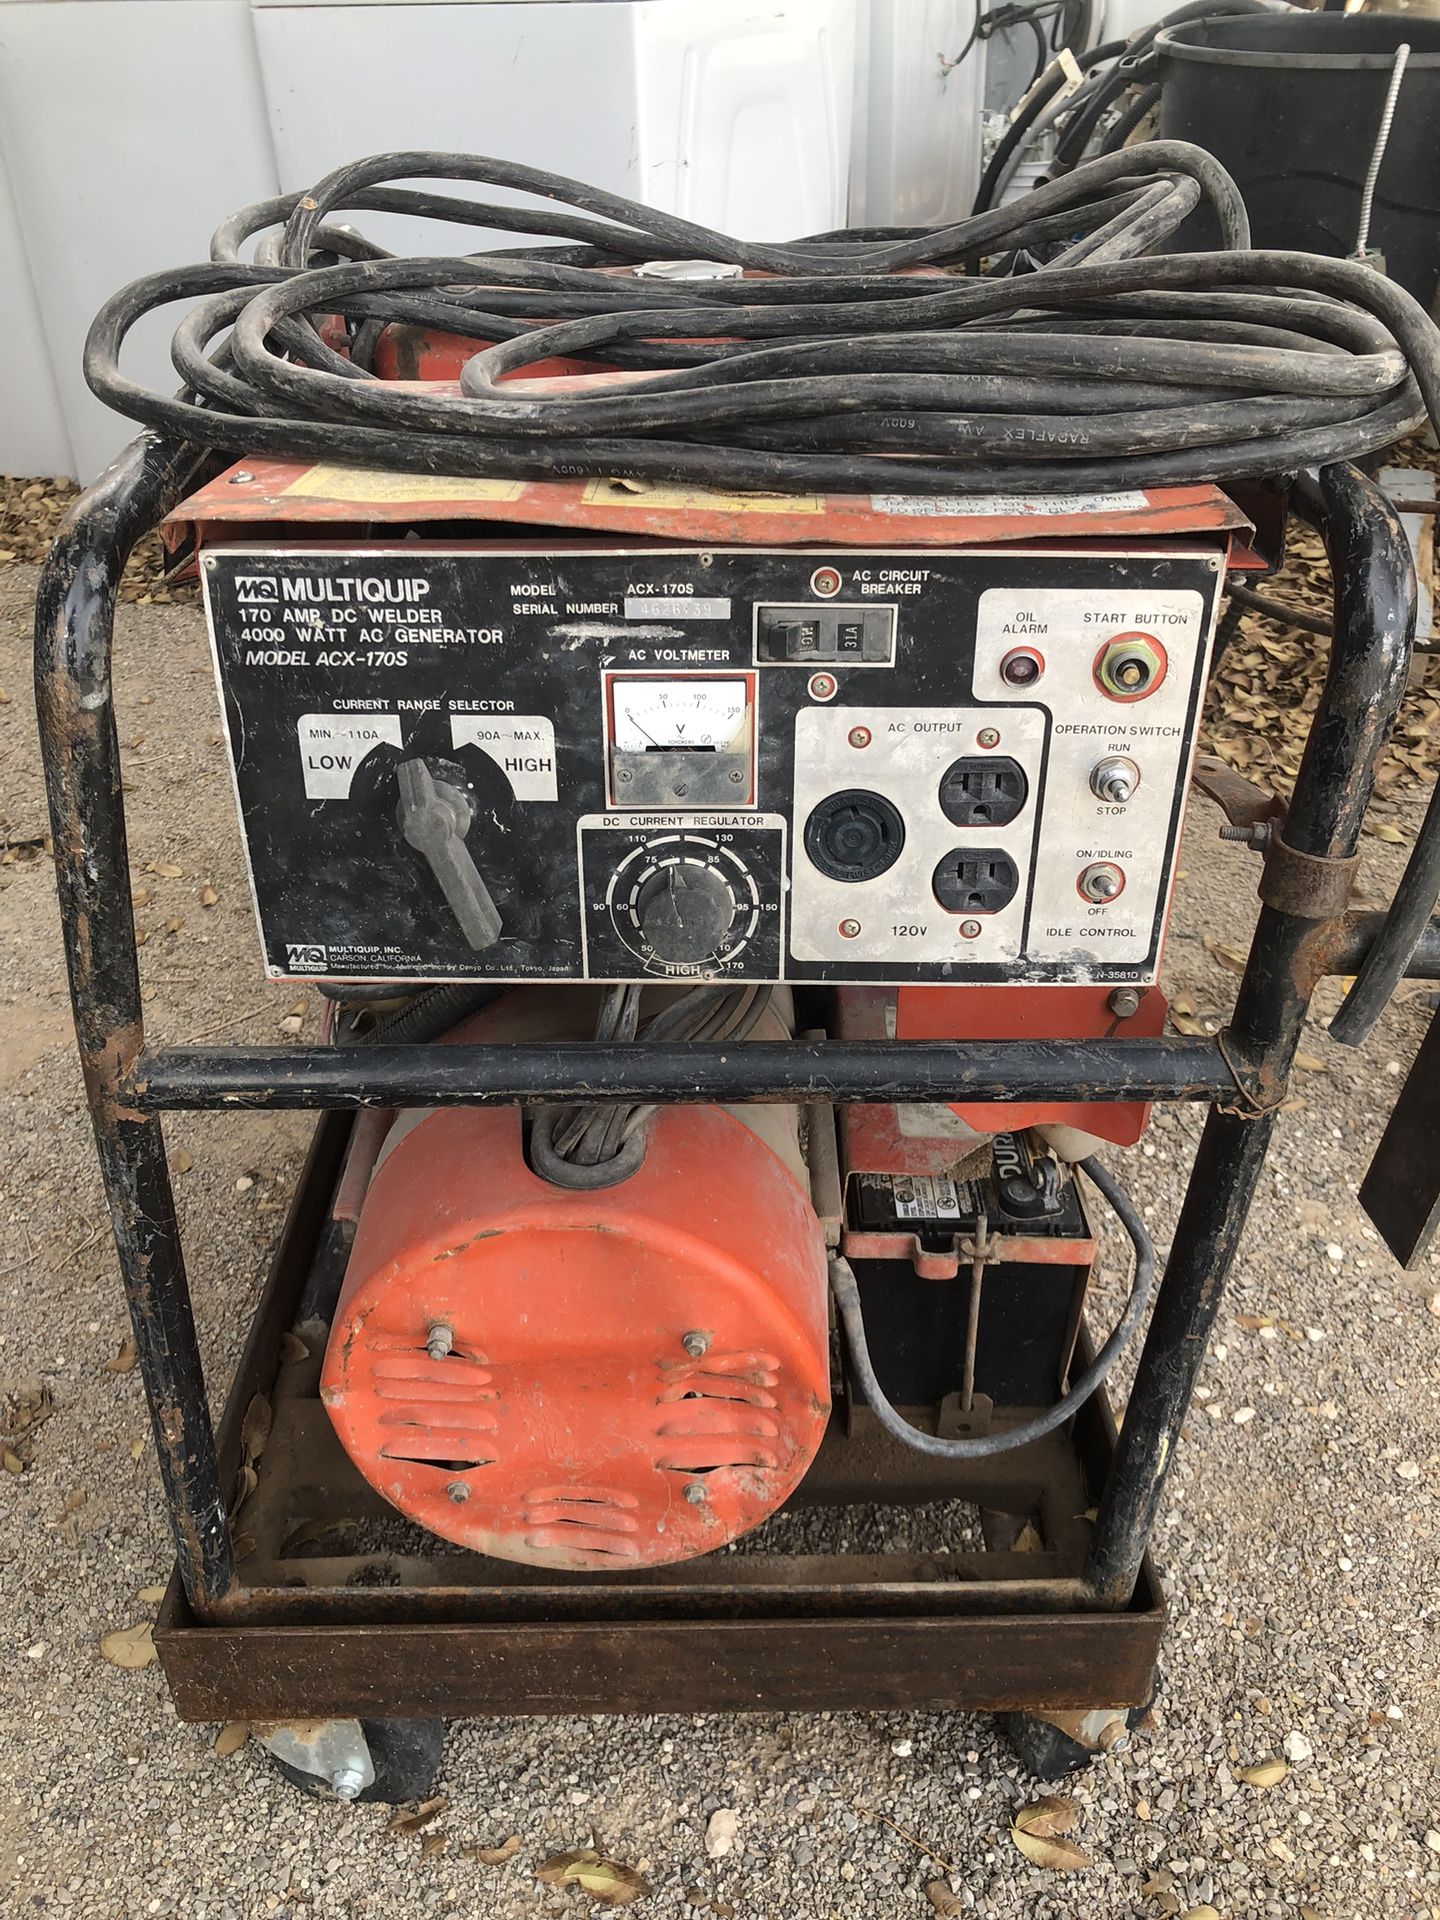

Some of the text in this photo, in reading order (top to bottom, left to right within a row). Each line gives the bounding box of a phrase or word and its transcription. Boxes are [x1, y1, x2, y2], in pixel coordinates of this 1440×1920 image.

[880, 417, 916, 428] 600V
[551, 464, 584, 475] 600V
[852, 570, 930, 581] AC CIRCUIT
[282, 577, 430, 603] MULTIQUIP
[510, 583, 695, 596] MODEL ACX-170S
[861, 583, 922, 595] BREAKER
[512, 603, 558, 615] SERIAL
[566, 603, 619, 614] NUMBER
[238, 608, 443, 624] 170 AMP DC WELDER
[1016, 611, 1037, 622] OIL
[1083, 612, 1188, 625] START BUTTON
[1002, 624, 1048, 634] ALARM
[241, 628, 503, 644] 4000 WATT AC GENERATOR
[844, 626, 858, 648] 31A
[245, 650, 408, 667] MODEL ACX-170S
[628, 649, 730, 661] AC VOLTMETER
[332, 700, 515, 711] CURRENT RANGE SELECTOR
[675, 724, 686, 734] V
[888, 722, 963, 733] AC OUTPUT
[1054, 724, 1181, 737] OPERATION SWITCH
[1107, 743, 1131, 752] RUN
[308, 755, 352, 770] LOW
[504, 758, 552, 772] HIGH
[1095, 806, 1127, 815] STOP
[603, 816, 764, 826] DC CURRENT REGULATOR
[628, 834, 647, 843] 110
[714, 834, 734, 842] 130
[1076, 849, 1133, 859] ON/IDLING
[645, 856, 658, 864] 75
[707, 855, 720, 864] 85
[593, 903, 605, 911] 90
[616, 903, 629, 911] 60
[736, 903, 749, 911] 95
[759, 903, 778, 911] 150
[1087, 907, 1109, 916] OFF
[891, 926, 928, 936] 120V
[1046, 928, 1137, 937] IDLE CONTROL
[384, 946, 404, 954] INC.
[641, 944, 653, 952] 50
[369, 954, 422, 963] CALIFORNIA
[547, 964, 569, 973] Japan
[726, 961, 745, 969] 170
[665, 965, 700, 976] HIGH
[992, 1133, 1023, 1179] DUR
